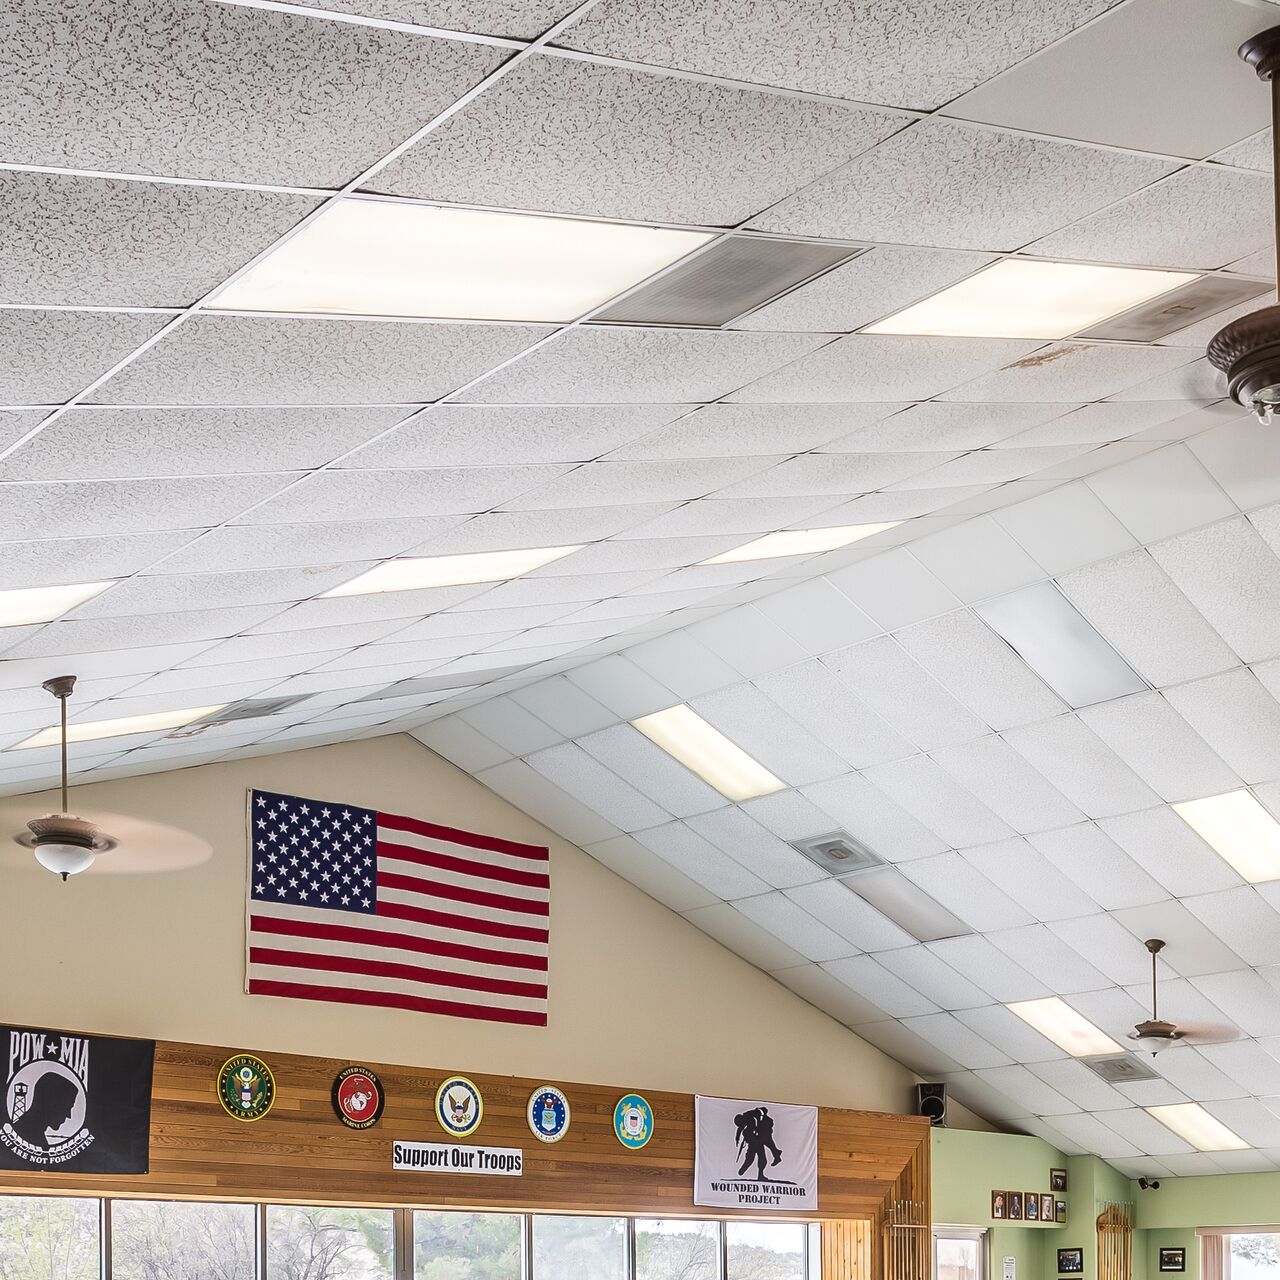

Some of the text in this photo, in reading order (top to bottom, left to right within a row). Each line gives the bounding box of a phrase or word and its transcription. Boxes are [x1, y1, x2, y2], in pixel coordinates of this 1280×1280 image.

[6, 1031, 90, 1093] POW MIA
[339, 1067, 376, 1082] UNITED STATES
[235, 1109, 259, 1117] ARMY
[11, 1147, 28, 1160] ARE
[29, 1155, 48, 1164] NOT
[49, 1134, 96, 1164] FORGOTTEN
[394, 1144, 522, 1172] Support Our Troops
[711, 1182, 806, 1196] WOUNDED WARRIOR
[738, 1194, 781, 1205] PROJECT
